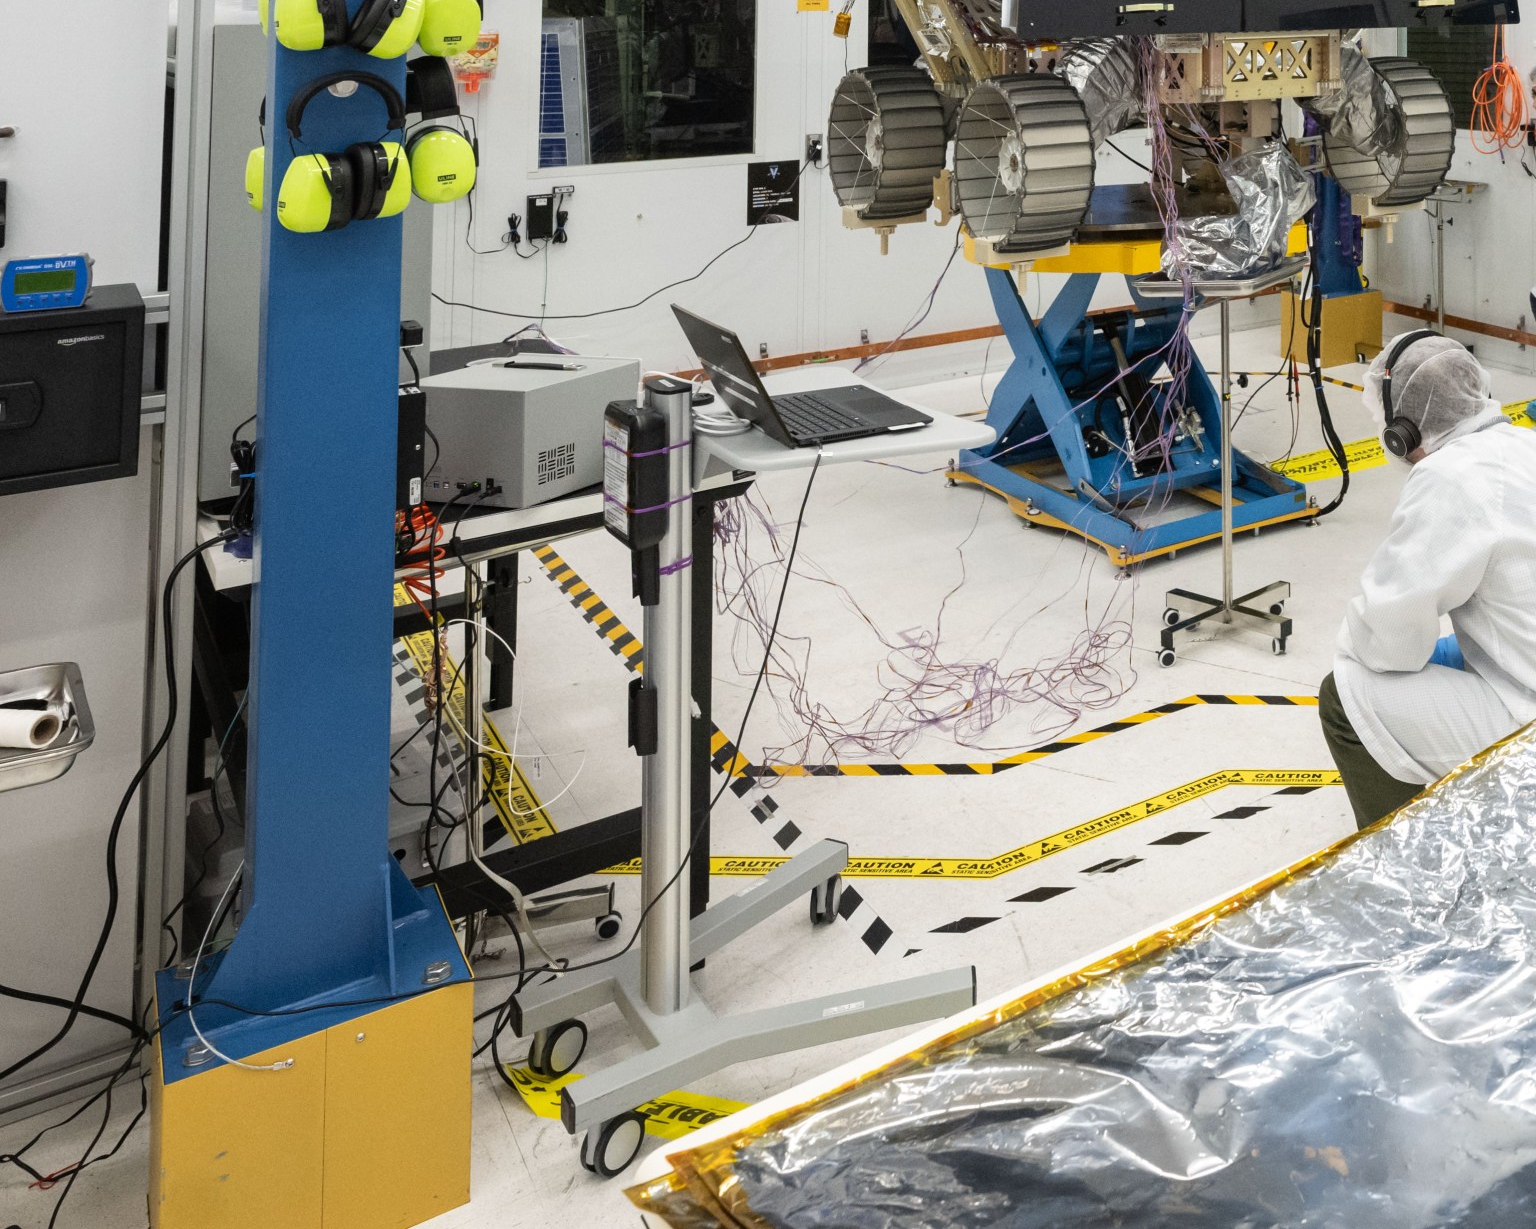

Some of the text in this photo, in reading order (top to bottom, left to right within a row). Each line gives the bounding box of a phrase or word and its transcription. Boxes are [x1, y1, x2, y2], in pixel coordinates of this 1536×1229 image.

[57, 334, 104, 345] amazonbasics
[494, 757, 513, 783] CAUTION
[1166, 774, 1227, 800] CAUTION
[513, 795, 538, 823] CAUTION
[1121, 814, 1139, 823] AREA
[1064, 811, 1131, 840] CAUTION
[1014, 855, 1032, 866] AREA
